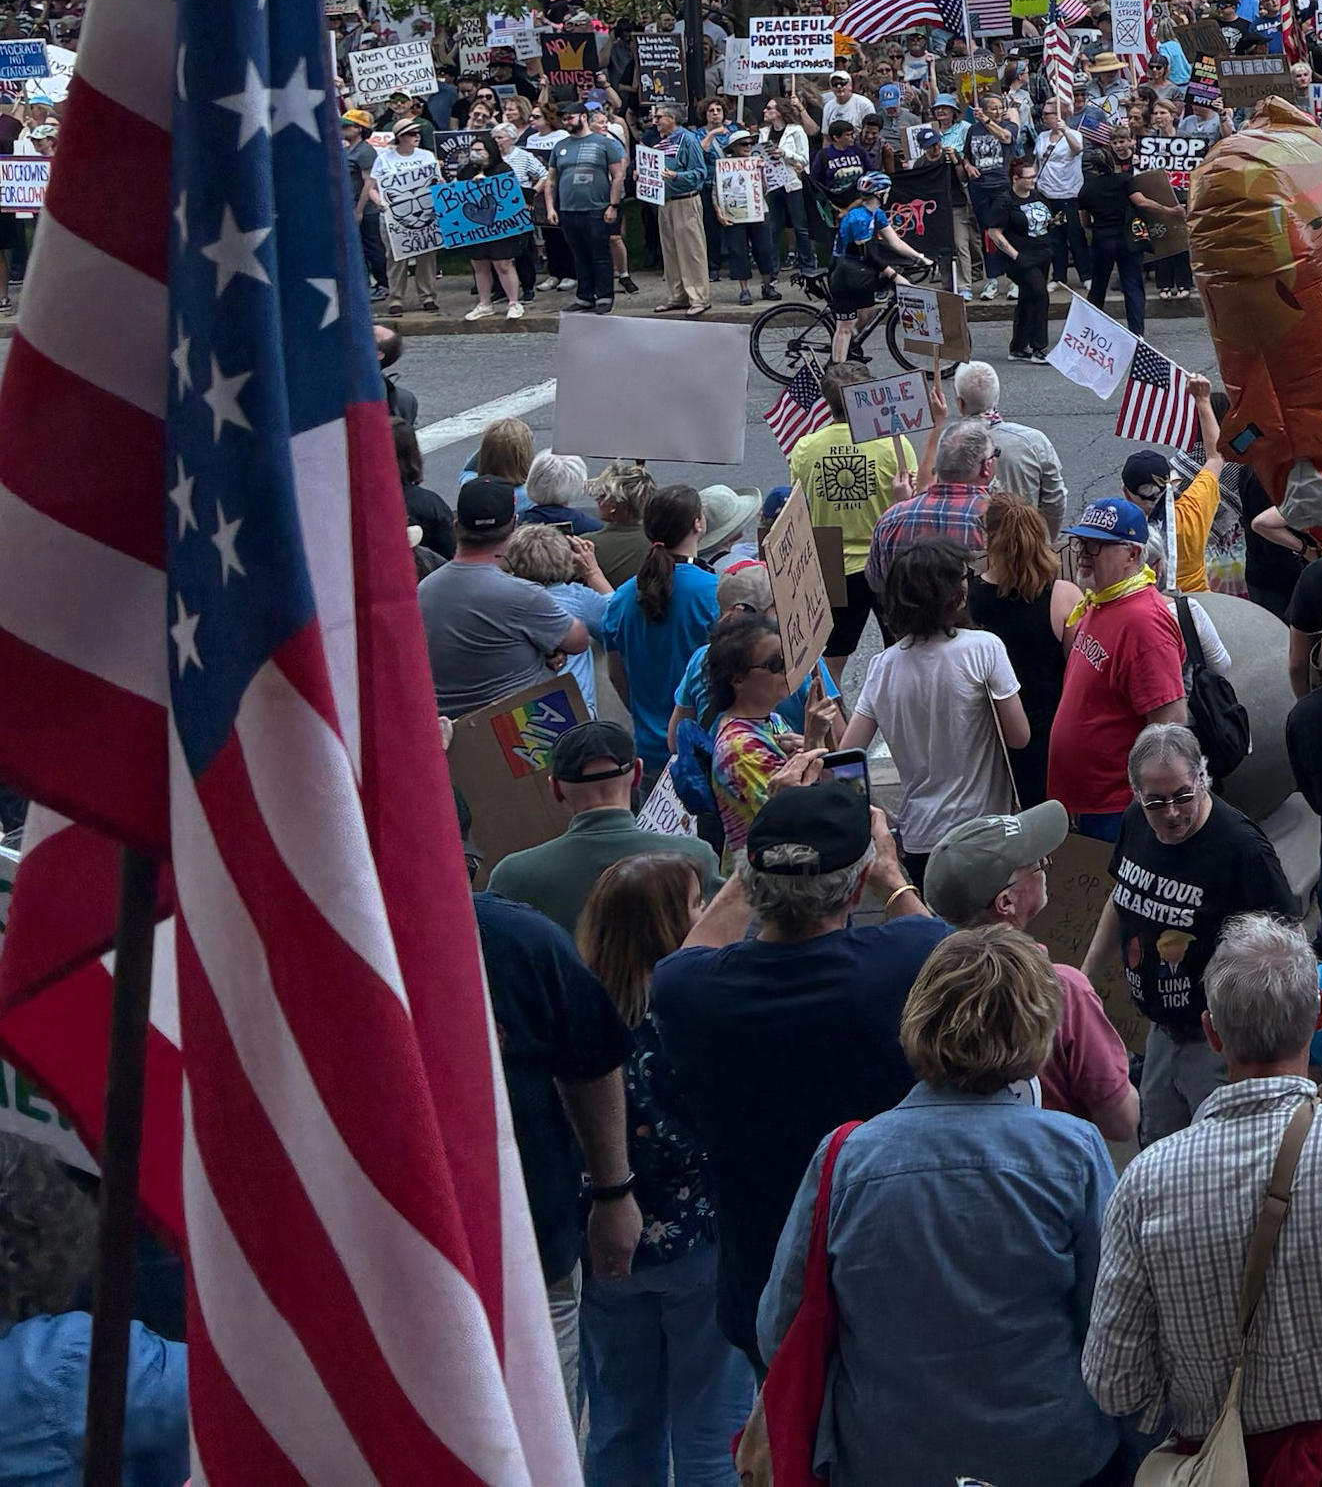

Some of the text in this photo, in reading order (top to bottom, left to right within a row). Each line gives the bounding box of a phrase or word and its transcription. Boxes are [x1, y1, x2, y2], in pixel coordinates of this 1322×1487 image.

[756, 19, 829, 33] PEACEFUL
[545, 38, 567, 55] NO
[751, 34, 833, 46] PROTESTERS
[354, 40, 431, 65] When CRUELTY
[768, 48, 814, 56] ARE NOT
[751, 59, 833, 70] INSURRECTIONISTS
[1221, 59, 1285, 77] DEFEND
[358, 67, 434, 94] COMPASSION
[550, 70, 594, 86] KINGS
[441, 137, 457, 153] NO
[1140, 137, 1206, 157] STOP
[718, 160, 731, 173] NO
[1140, 154, 1204, 172] PROJECT
[2, 164, 48, 181] NO CROWNS
[381, 165, 438, 189] CAT LADY
[438, 177, 514, 213] Buffalo
[639, 184, 659, 199] GREAT
[445, 207, 533, 247] IMMIGRANTS
[401, 233, 443, 253] SQUAD
[854, 380, 915, 408] RULE
[880, 405, 897, 416] OF
[872, 407, 924, 438] LAW
[806, 589, 825, 624] ALL
[1157, 875, 1205, 908] YOUR
[1112, 883, 1196, 928] ARASITES
[1157, 975, 1192, 993] LUNA
[1161, 990, 1191, 1009] TICK
